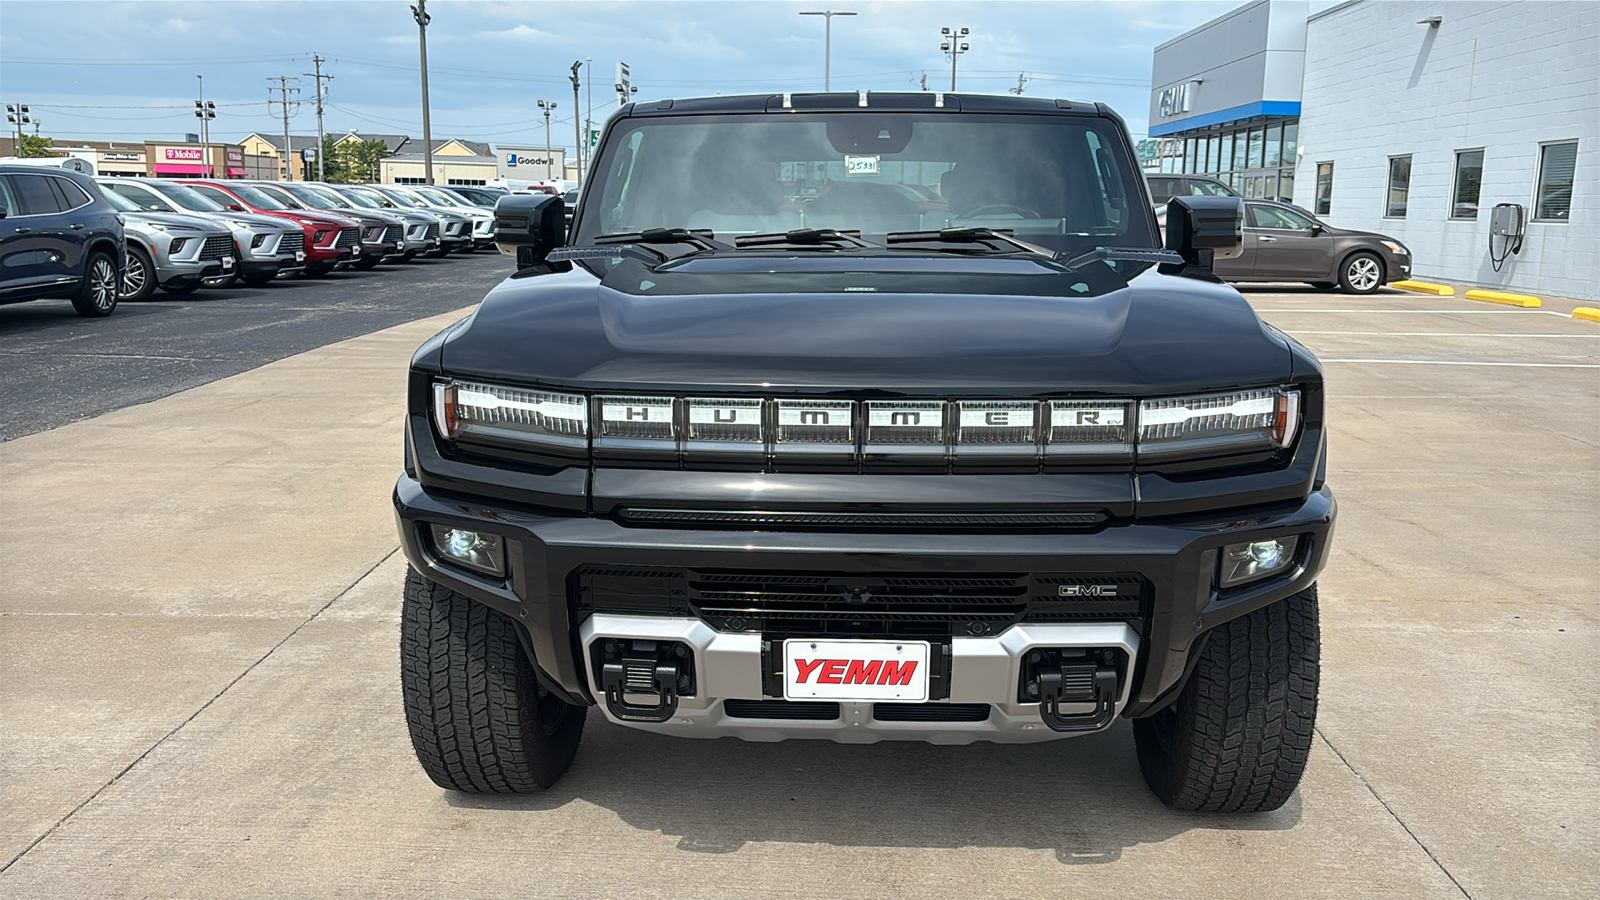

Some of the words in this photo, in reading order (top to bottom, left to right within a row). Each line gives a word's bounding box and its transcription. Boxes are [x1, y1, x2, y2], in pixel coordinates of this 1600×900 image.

[517, 156, 554, 165] Goodwll
[849, 161, 876, 171] 25331
[1058, 584, 1117, 597] GMC
[794, 658, 919, 686] YEMM
